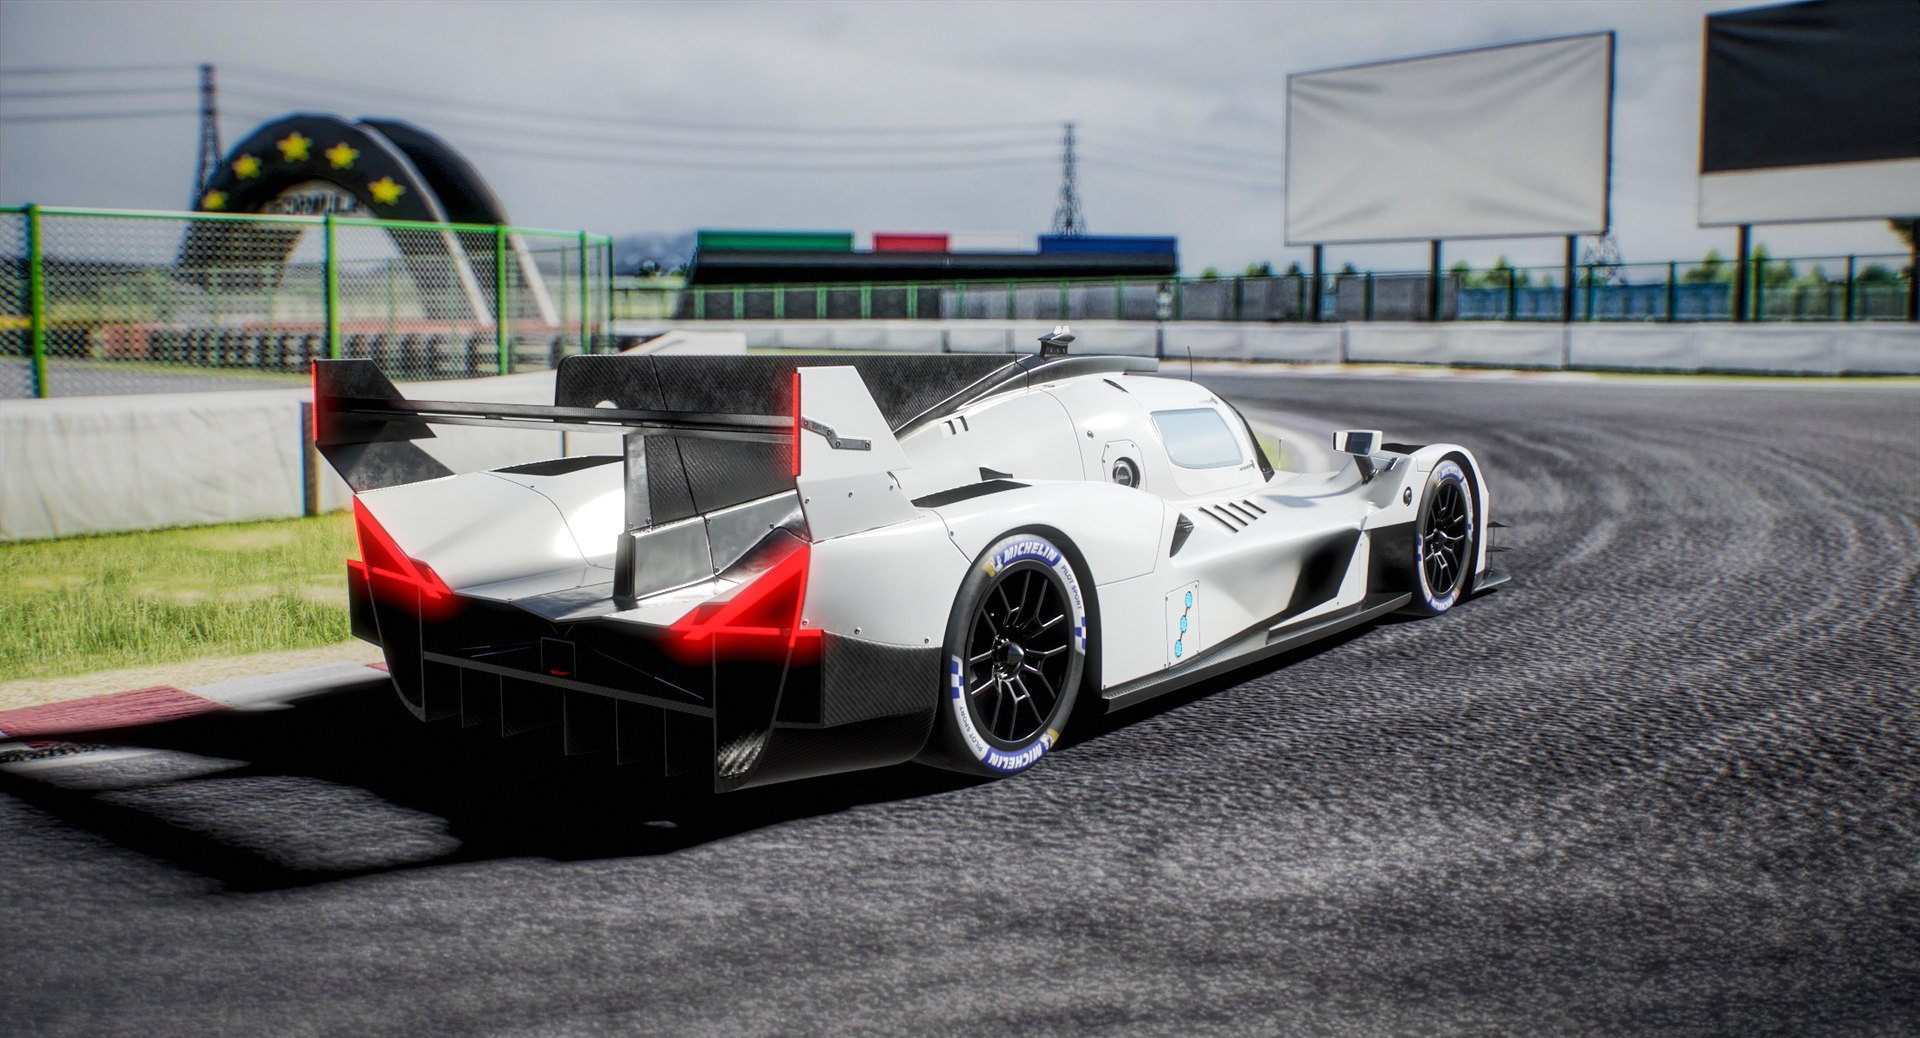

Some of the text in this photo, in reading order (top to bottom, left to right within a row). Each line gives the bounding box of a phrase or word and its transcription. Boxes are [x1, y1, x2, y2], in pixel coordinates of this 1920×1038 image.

[1003, 541, 1057, 563] MICHELIN
[1061, 564, 1082, 609] PILOT SPORT
[959, 706, 983, 752] PILOT SPORT
[987, 743, 1043, 770] MICHELIN
